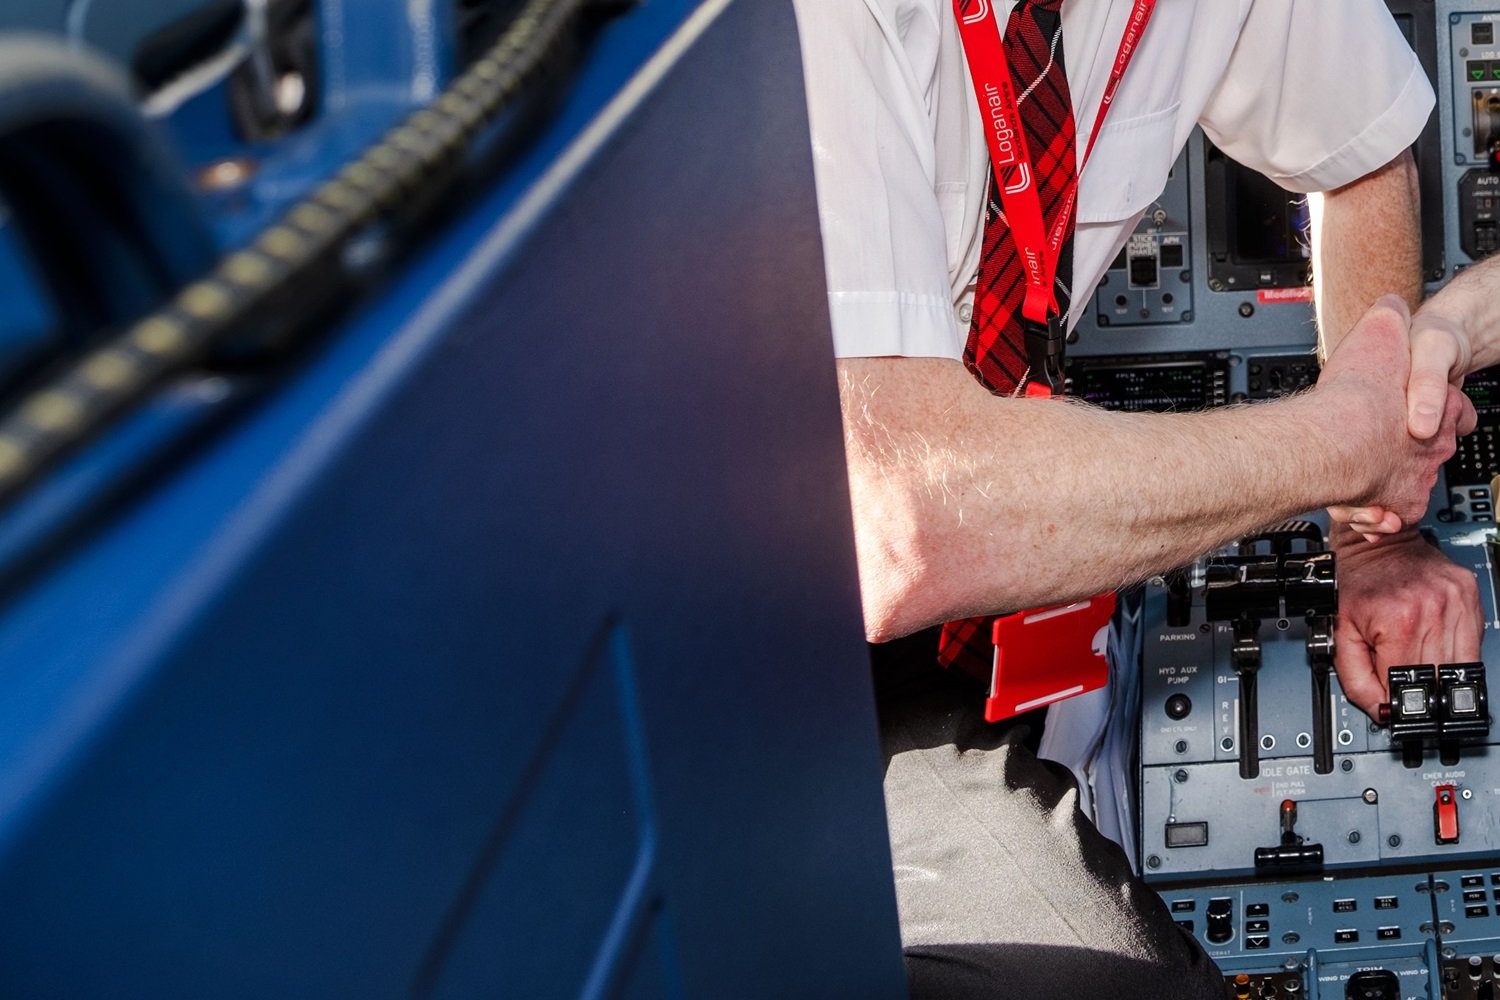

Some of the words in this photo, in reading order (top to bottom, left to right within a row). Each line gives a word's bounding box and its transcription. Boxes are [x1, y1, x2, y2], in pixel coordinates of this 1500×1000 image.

[985, 82, 1015, 165] Loganair
[1240, 566, 1247, 582] 1
[1305, 563, 1316, 580] 2
[1159, 667, 1175, 675] HYD
[1263, 768, 1282, 776] IDLE
[1287, 766, 1310, 775] GATE
